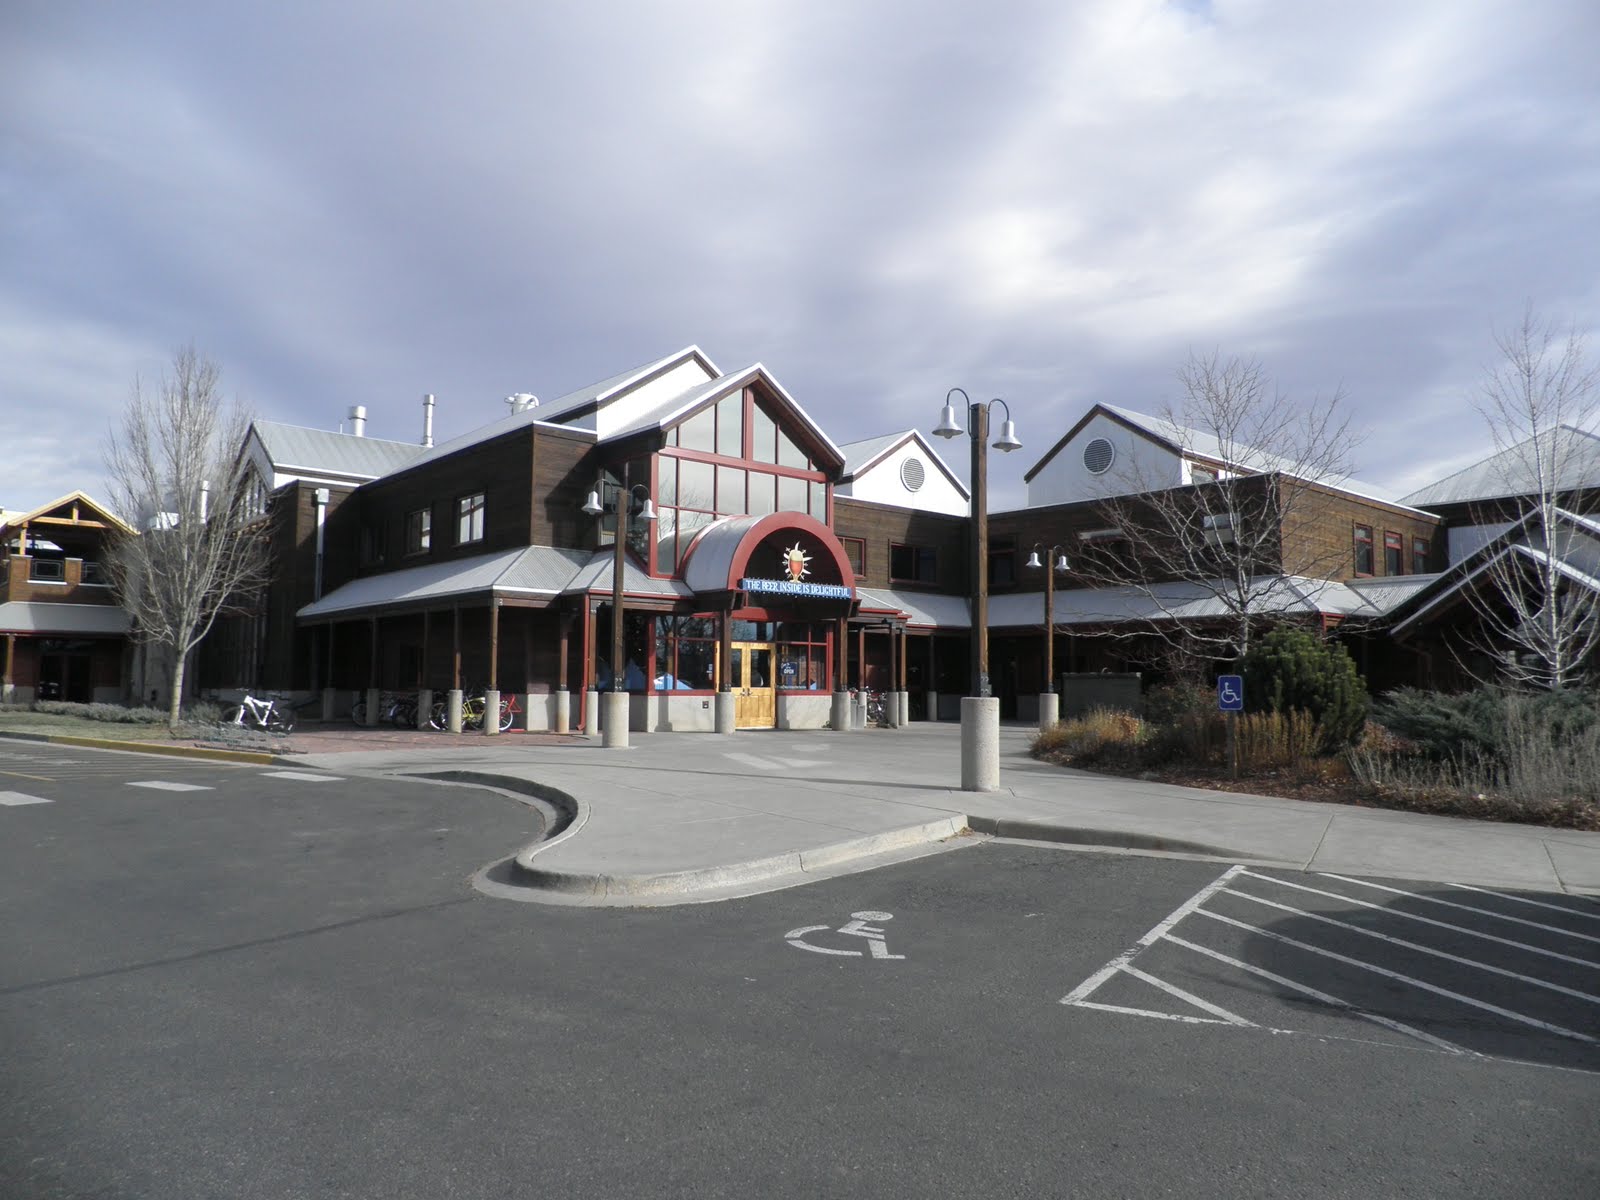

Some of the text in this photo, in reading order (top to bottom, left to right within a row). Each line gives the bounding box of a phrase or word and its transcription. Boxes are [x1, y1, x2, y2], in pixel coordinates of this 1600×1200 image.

[746, 580, 850, 597] THE BEER INSIDE IS DELIGHTFUL
